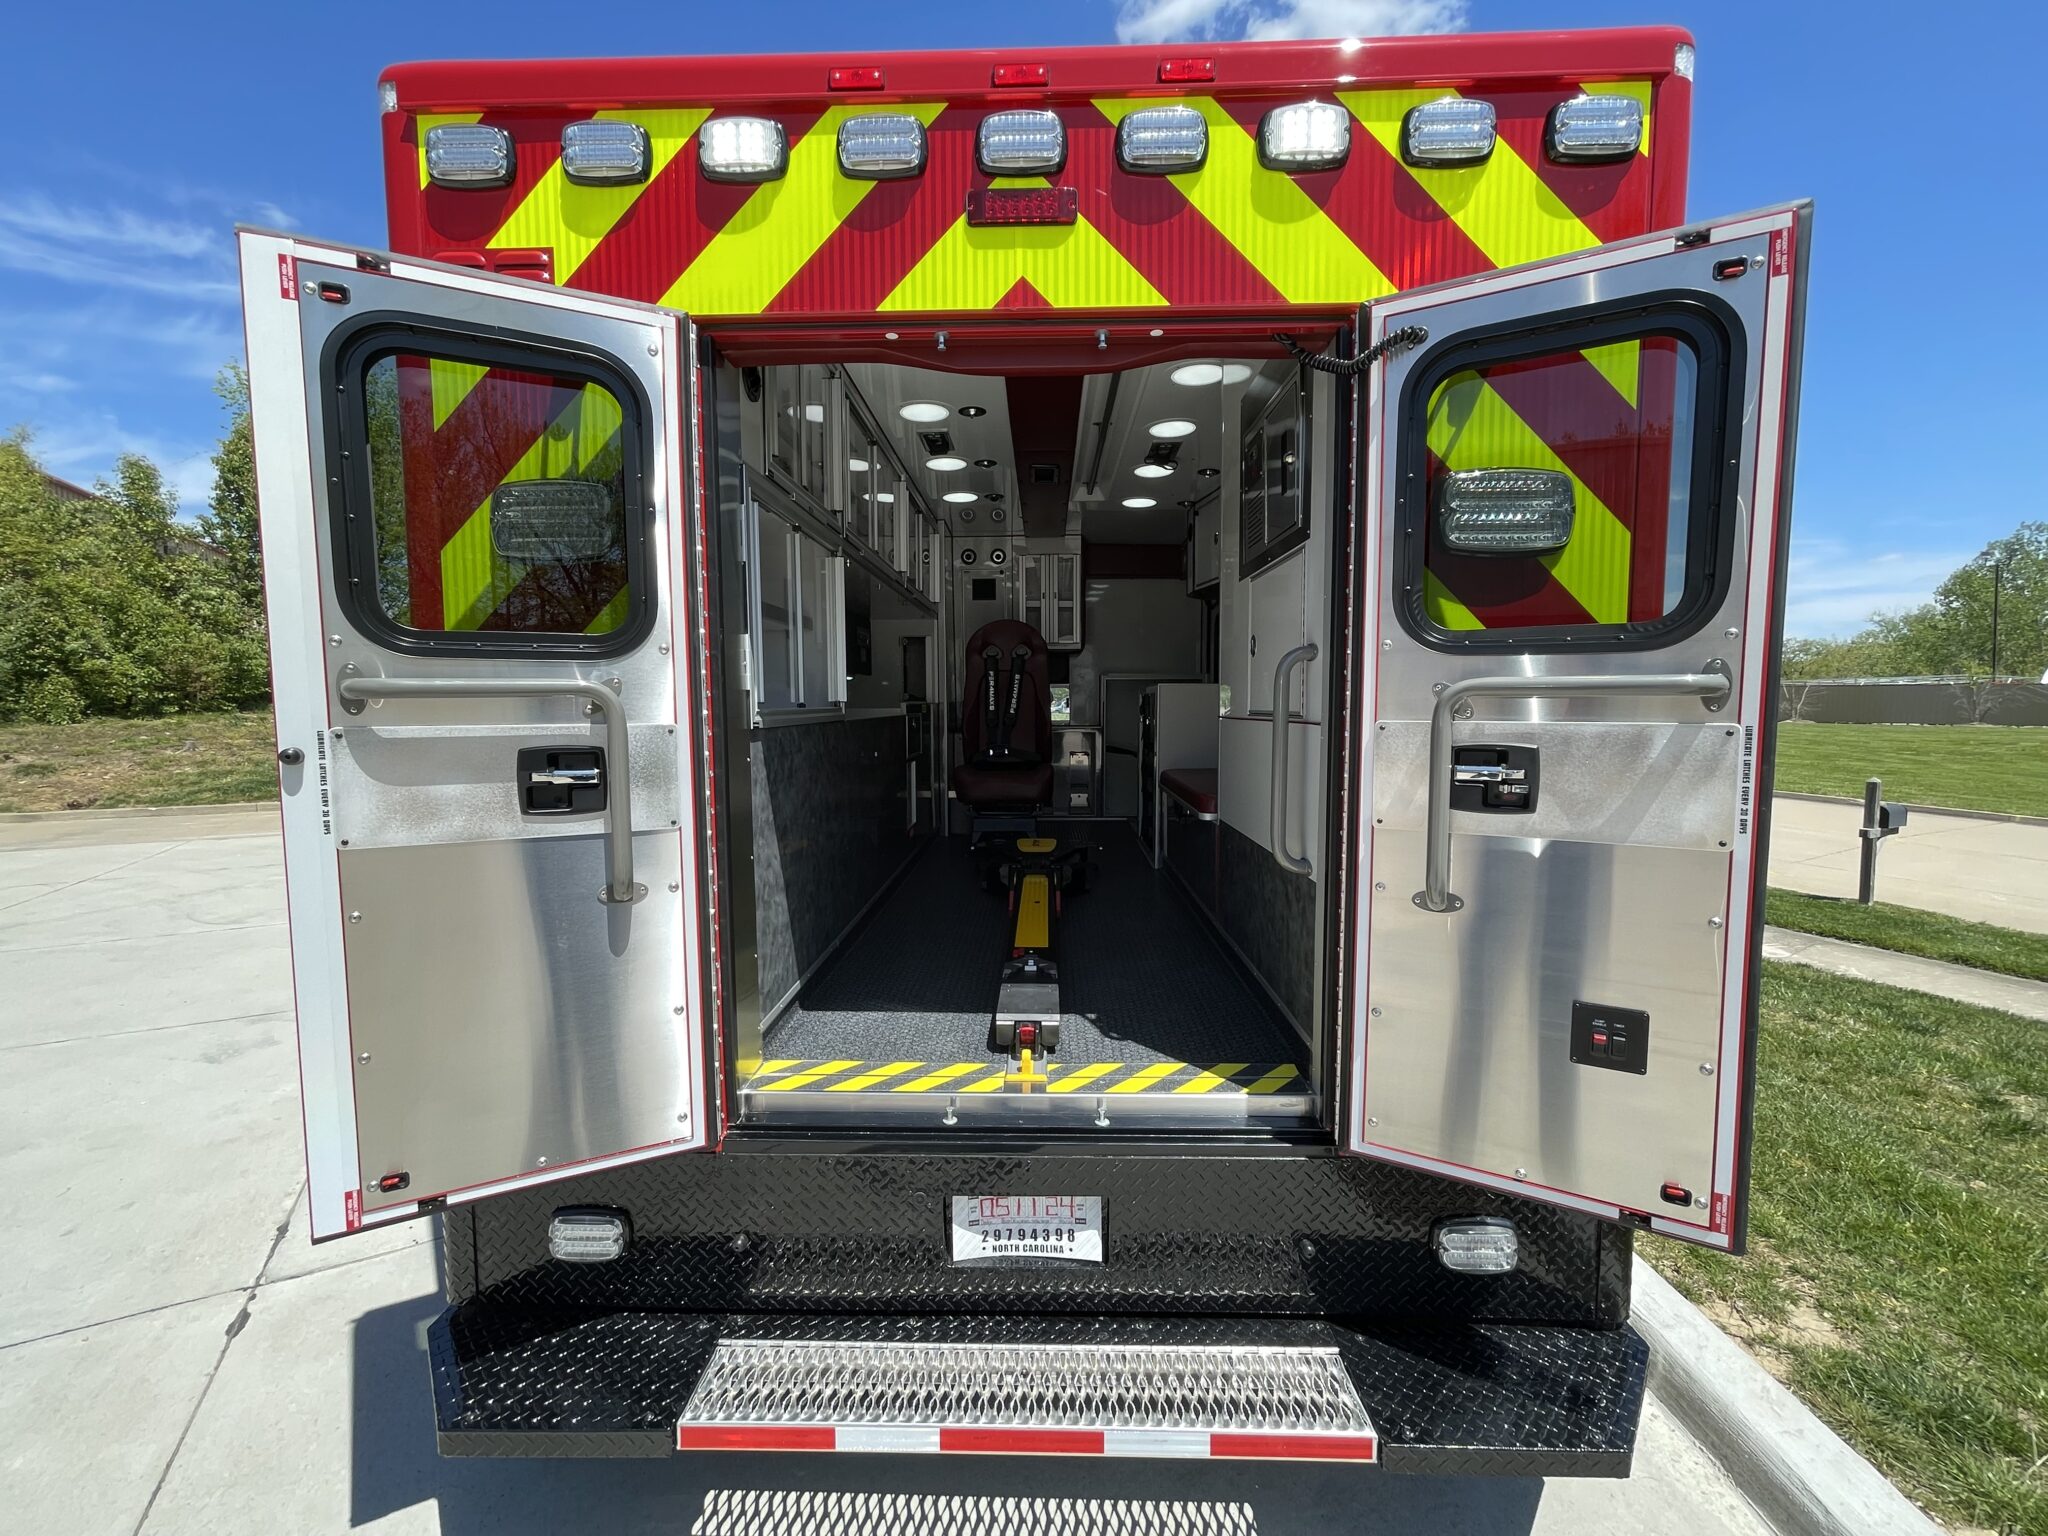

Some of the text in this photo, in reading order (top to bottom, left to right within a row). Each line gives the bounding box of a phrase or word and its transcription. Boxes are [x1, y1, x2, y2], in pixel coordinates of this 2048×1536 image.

[317, 730, 331, 835] LUBRICATE LATCHES EVERY 30 DAYS
[1739, 726, 1753, 834] LUBRICATE LATCHES EVERY 30 DAYS
[982, 1228, 1075, 1243] 29794398
[992, 1244, 1064, 1254] NORTH CAROLINA
